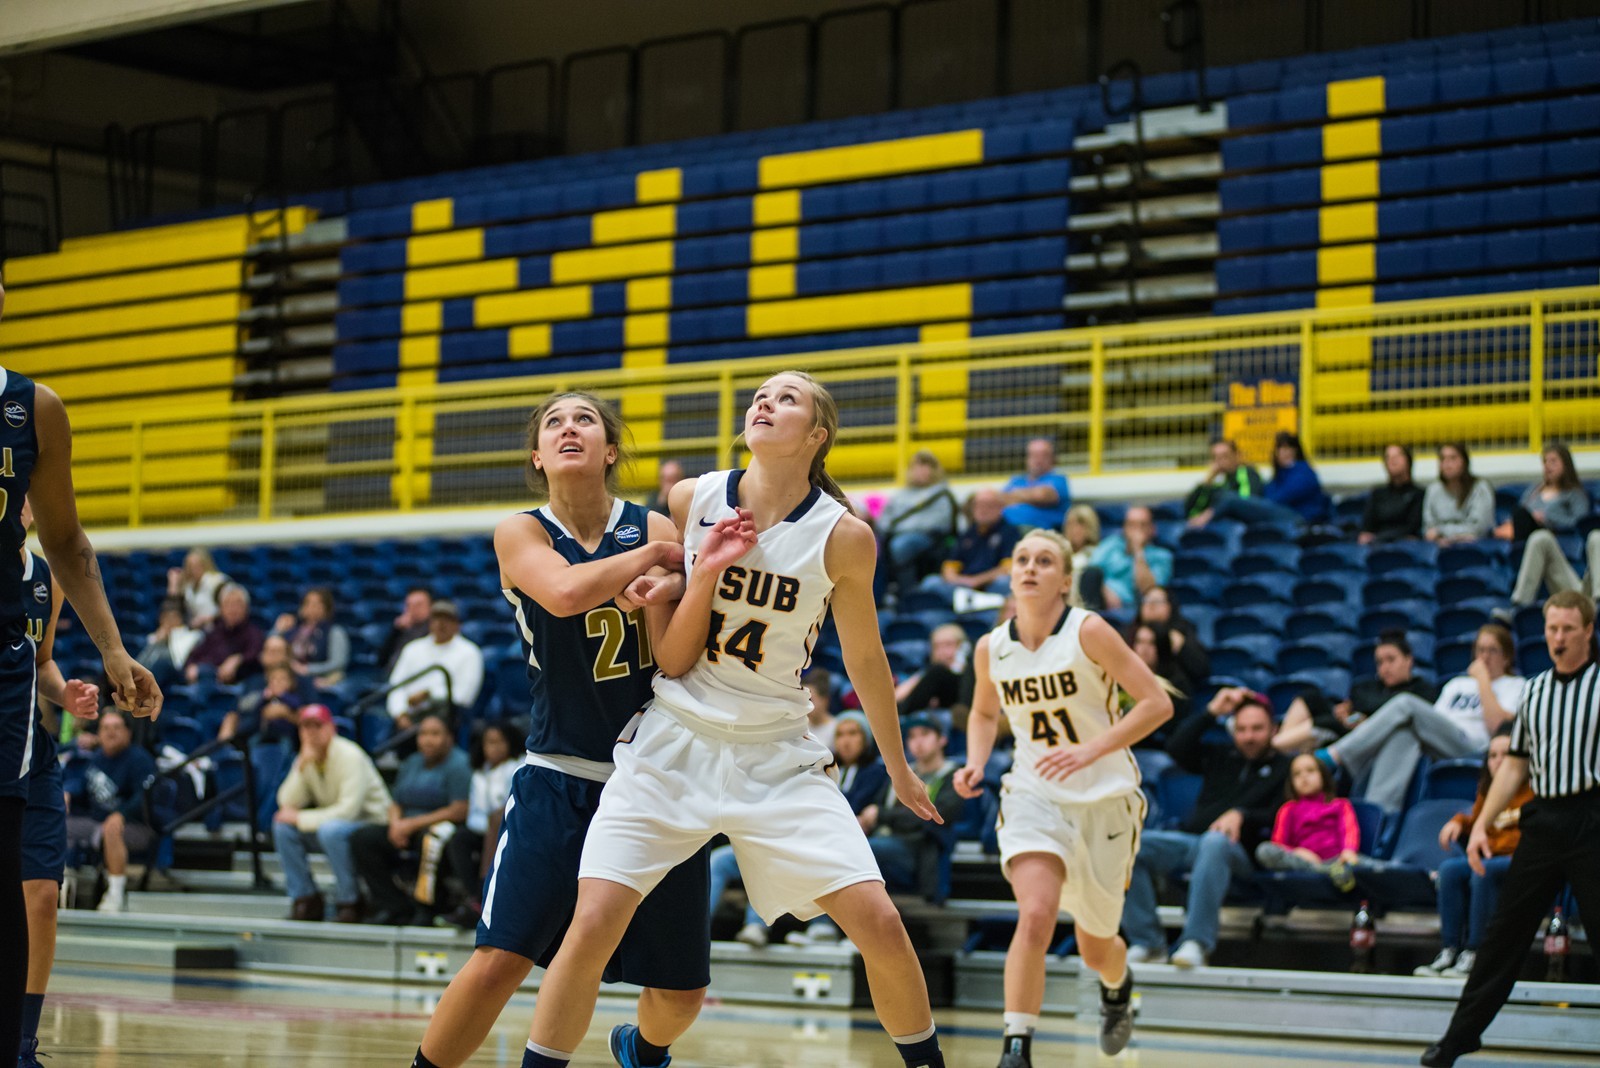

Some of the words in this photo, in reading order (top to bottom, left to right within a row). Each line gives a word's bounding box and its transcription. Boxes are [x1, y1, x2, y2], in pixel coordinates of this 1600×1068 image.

[691, 553, 800, 613] SUB
[585, 606, 653, 682] 21
[1000, 669, 1079, 706] MSUB
[1031, 707, 1081, 747] 41
